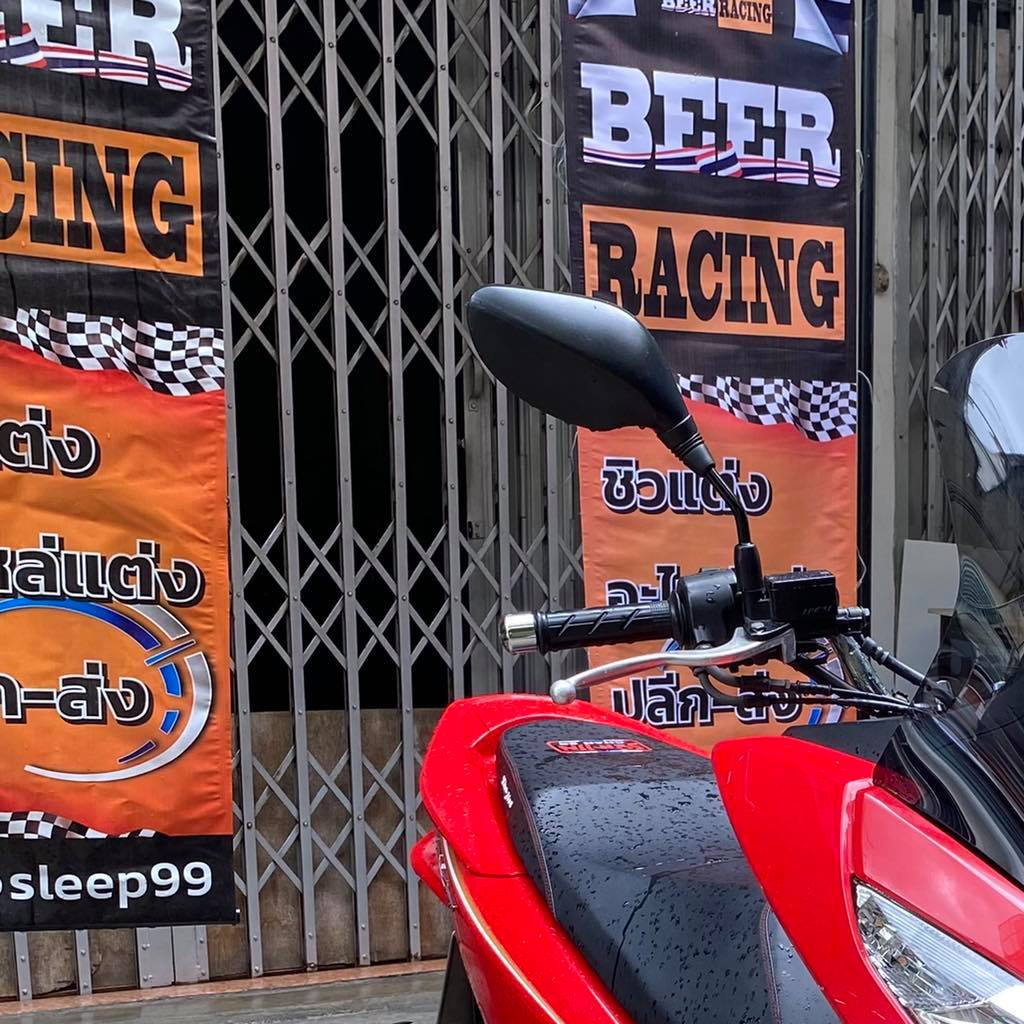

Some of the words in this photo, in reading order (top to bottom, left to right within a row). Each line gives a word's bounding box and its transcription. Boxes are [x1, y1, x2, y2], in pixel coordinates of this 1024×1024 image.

[719, 0, 772, 24] RACING
[580, 62, 841, 188] BEER
[589, 220, 839, 329] RACING
[0, 861, 213, 909] sleep99
